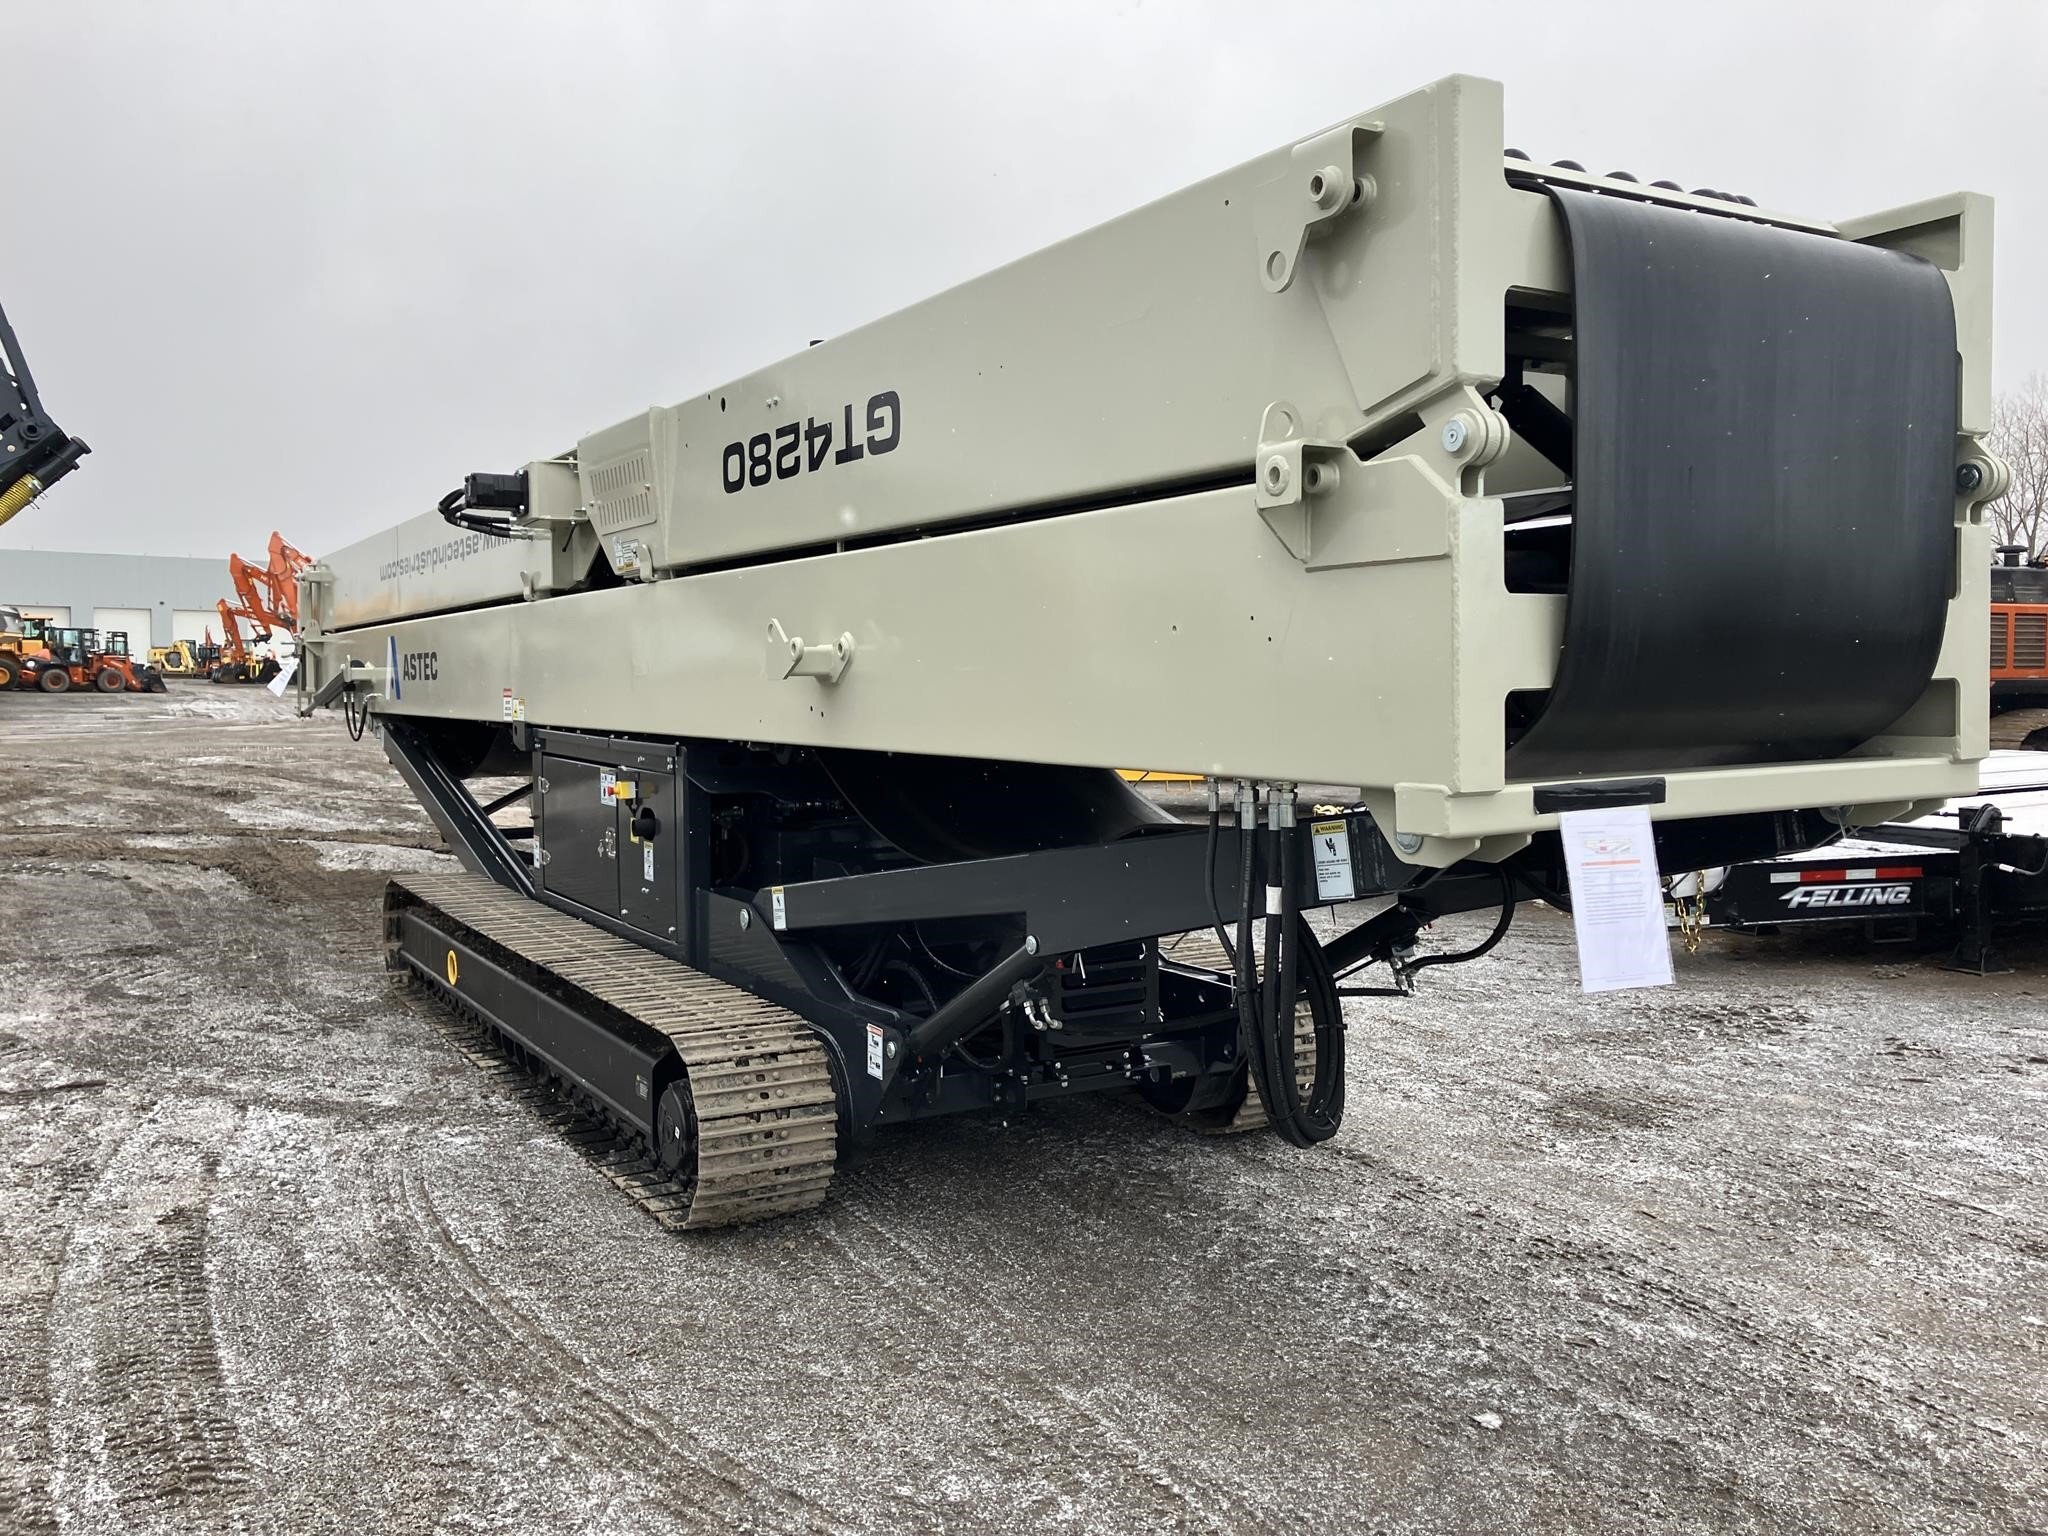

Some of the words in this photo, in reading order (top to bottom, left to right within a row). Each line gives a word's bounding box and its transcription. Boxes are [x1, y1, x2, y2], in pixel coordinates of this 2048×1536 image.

[723, 391, 901, 494] GT4280
[403, 651, 438, 681] ASTEC
[1320, 824, 1344, 832] WARNING
